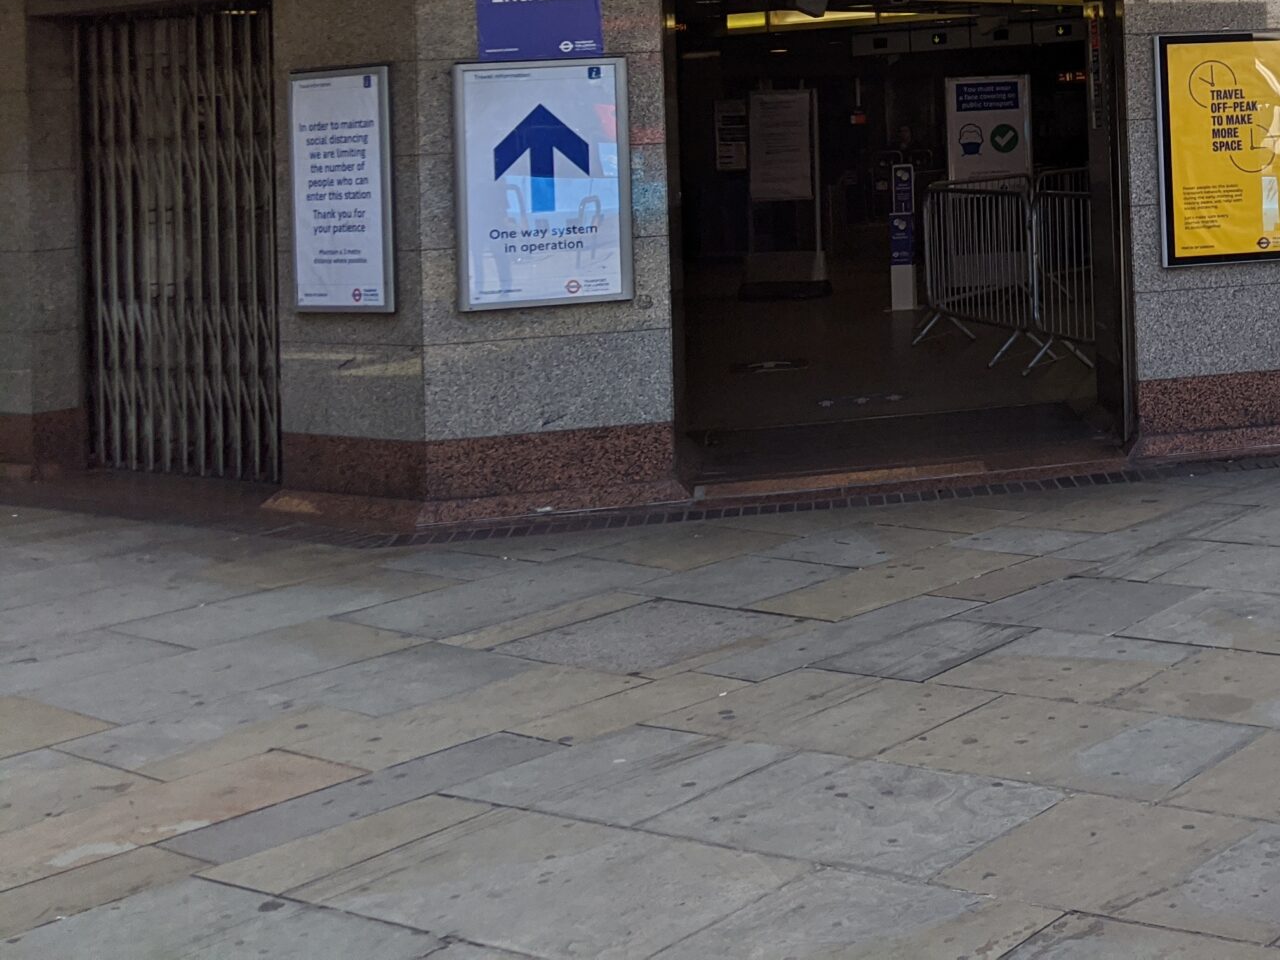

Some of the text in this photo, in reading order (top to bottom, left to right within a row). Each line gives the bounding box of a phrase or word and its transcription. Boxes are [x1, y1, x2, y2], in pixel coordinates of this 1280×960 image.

[1210, 89, 1245, 100] TRAVEL
[308, 122, 328, 131] order
[330, 121, 339, 130] to
[341, 120, 374, 129] maintain
[1211, 113, 1253, 126] TO MAKE
[1212, 127, 1239, 138] MORE
[306, 134, 368, 145] social distancing
[1212, 140, 1243, 152] SPACE
[309, 148, 366, 159] we are limiting
[310, 161, 365, 173] the number of
[308, 176, 369, 189] people who can
[306, 189, 371, 201] enter this station
[313, 208, 366, 220] Thank you for
[313, 222, 366, 235] your patience
[489, 224, 598, 240] One way system
[504, 240, 583, 253] in operation
